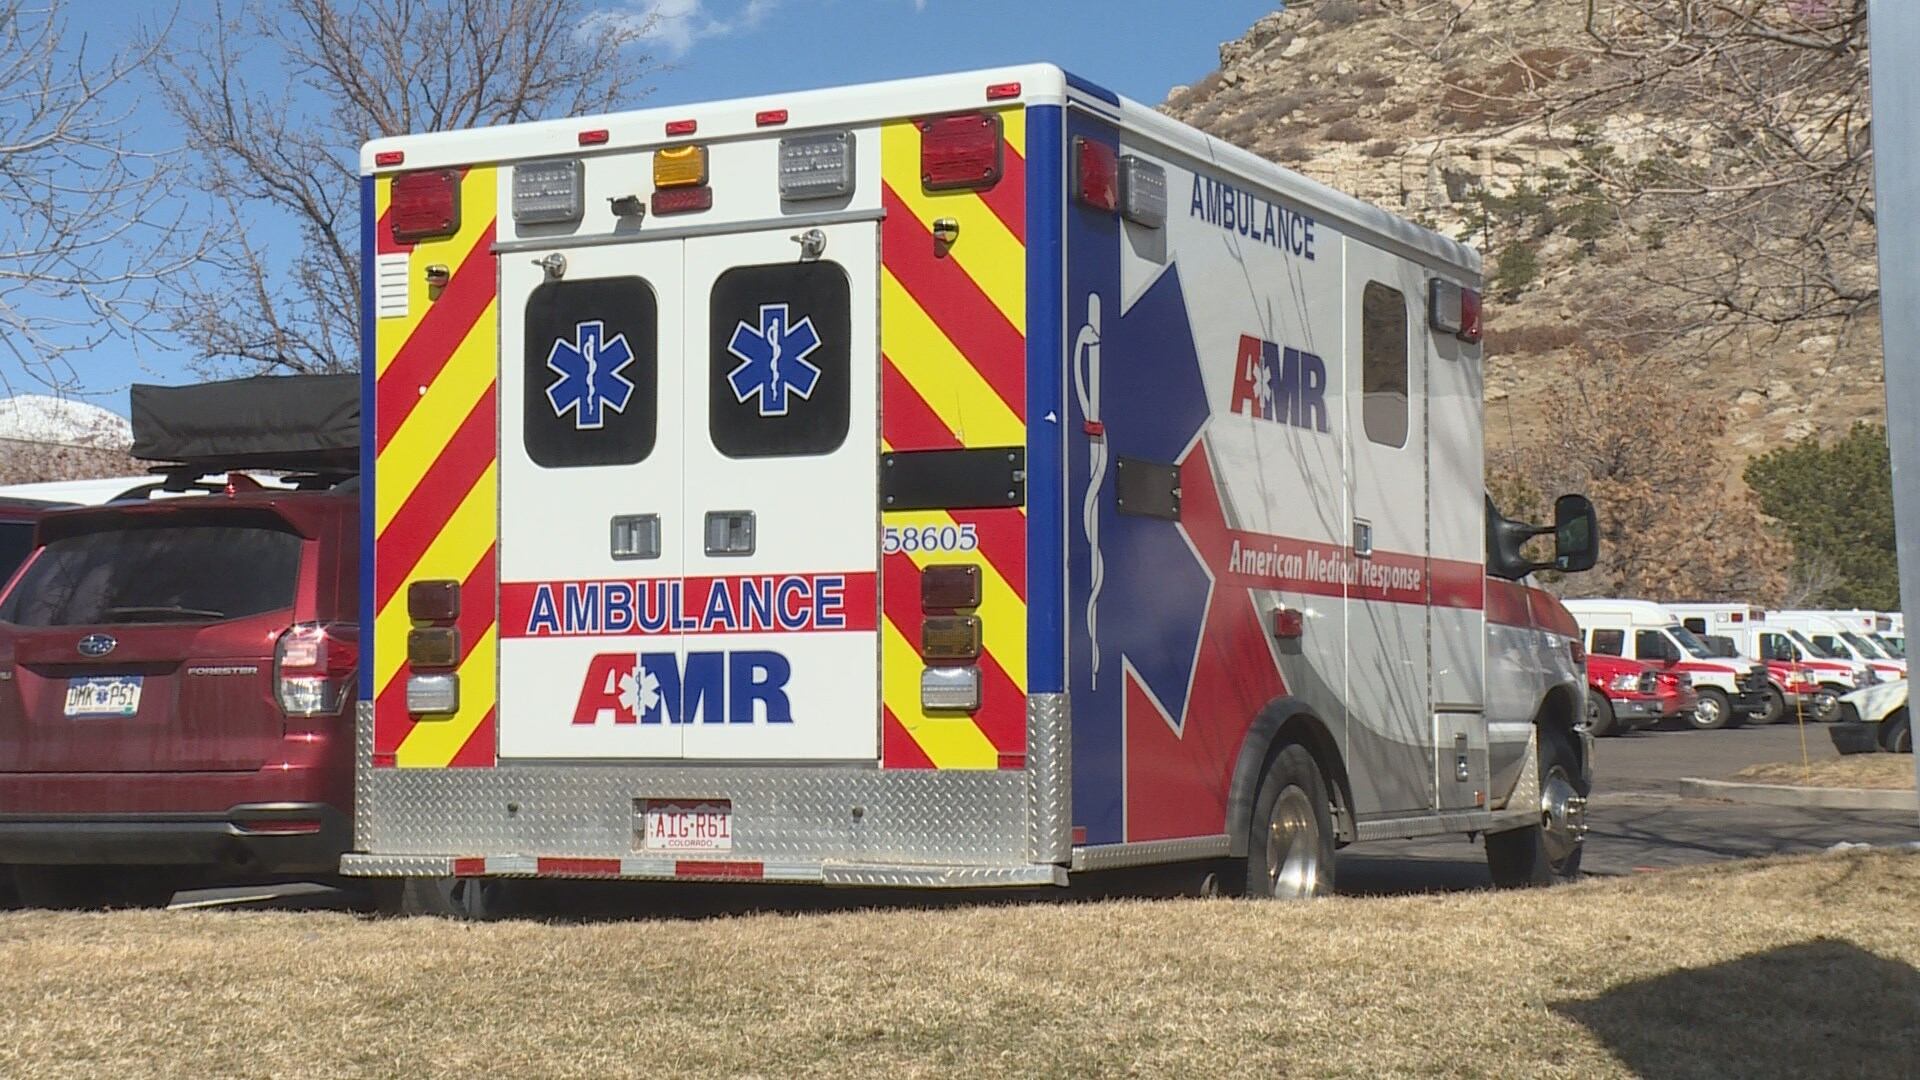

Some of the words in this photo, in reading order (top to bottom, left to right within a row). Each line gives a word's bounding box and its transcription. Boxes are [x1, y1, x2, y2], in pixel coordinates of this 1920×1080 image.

[1190, 171, 1316, 261] AMBULANCE
[1230, 333, 1328, 434] AMR
[882, 525, 979, 552] 58605
[1228, 539, 1303, 580] American
[1304, 549, 1359, 585] Medical
[1362, 558, 1421, 596] Response
[526, 576, 847, 636] AMBULANCE
[187, 666, 259, 677] FORESTER
[572, 650, 795, 725] AMR
[668, 839, 713, 848] COLORADO
